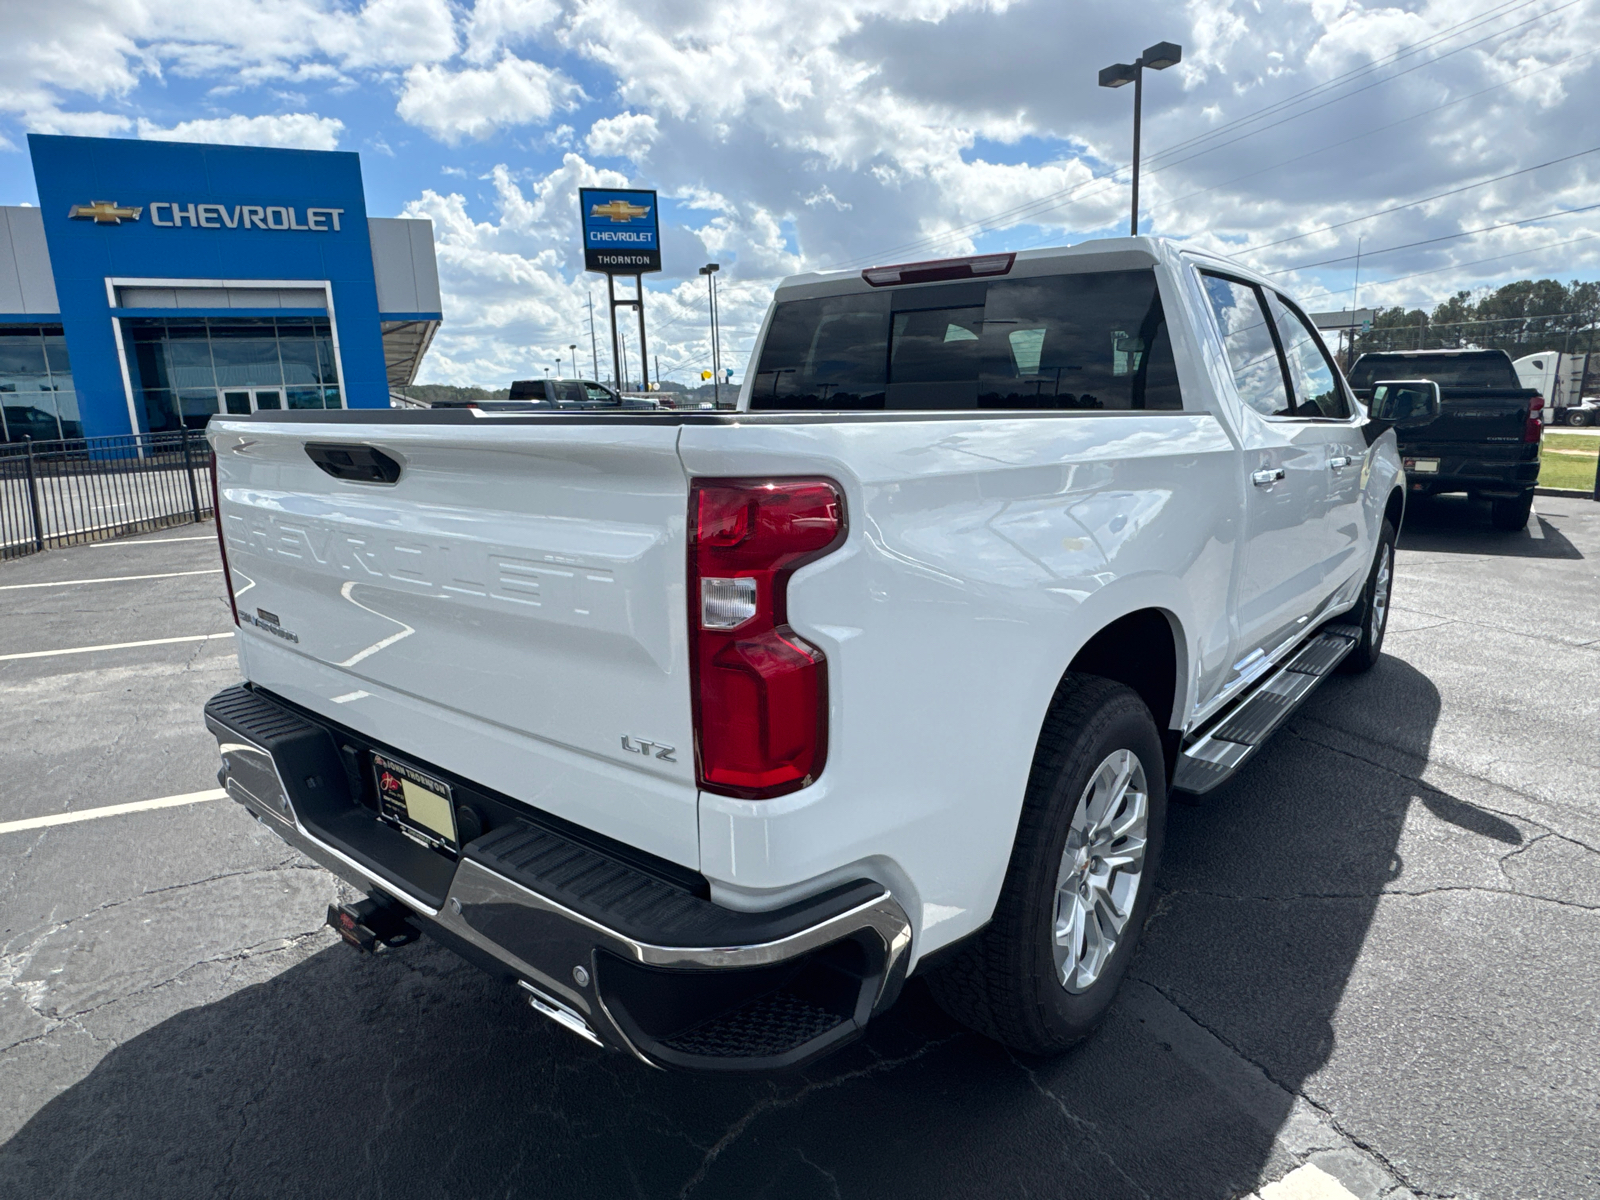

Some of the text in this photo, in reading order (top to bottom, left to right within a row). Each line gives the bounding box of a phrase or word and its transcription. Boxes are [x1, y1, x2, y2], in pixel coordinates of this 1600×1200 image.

[150, 202, 345, 231] CHEVROLET
[590, 231, 653, 242] CHEVROLET
[597, 255, 650, 264] THORNTON
[621, 735, 677, 763] LTZ
